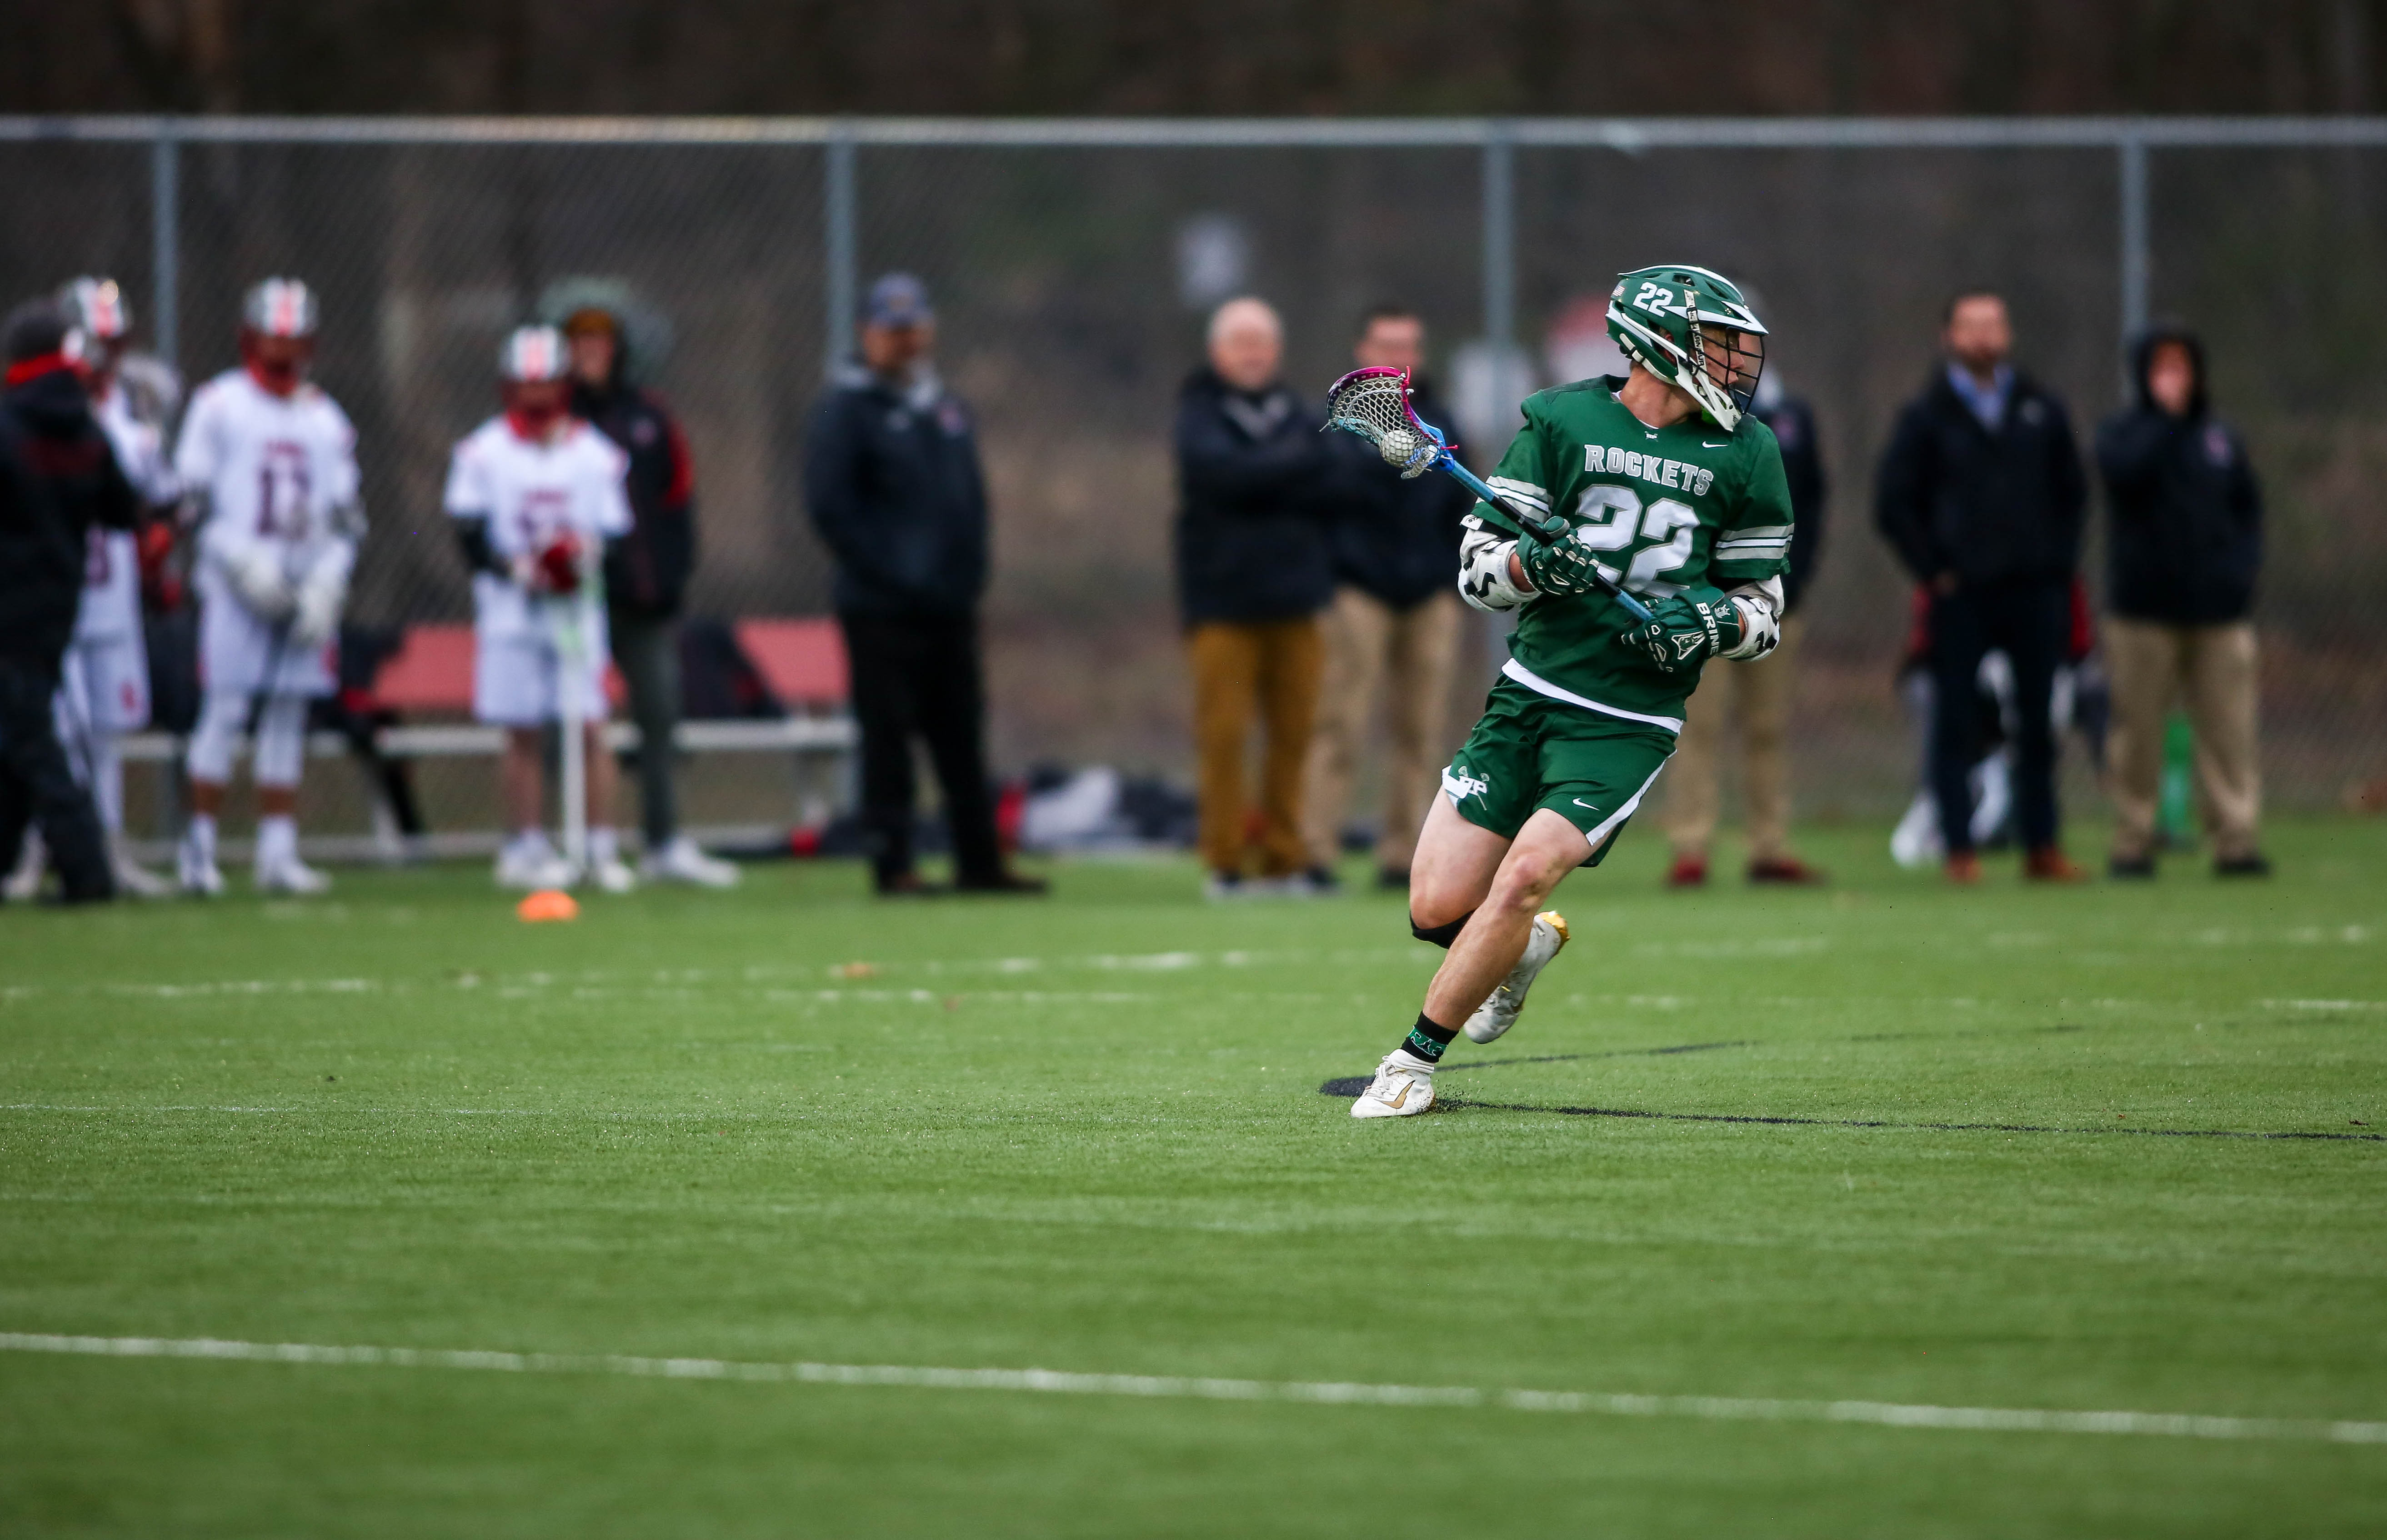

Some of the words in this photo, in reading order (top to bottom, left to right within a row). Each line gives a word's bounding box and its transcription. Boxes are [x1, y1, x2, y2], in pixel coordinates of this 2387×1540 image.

[1632, 282, 1674, 317] 22
[1584, 444, 1714, 496] ROCKETS
[1575, 484, 1701, 599] 22
[1696, 602, 1719, 655] BRINE
